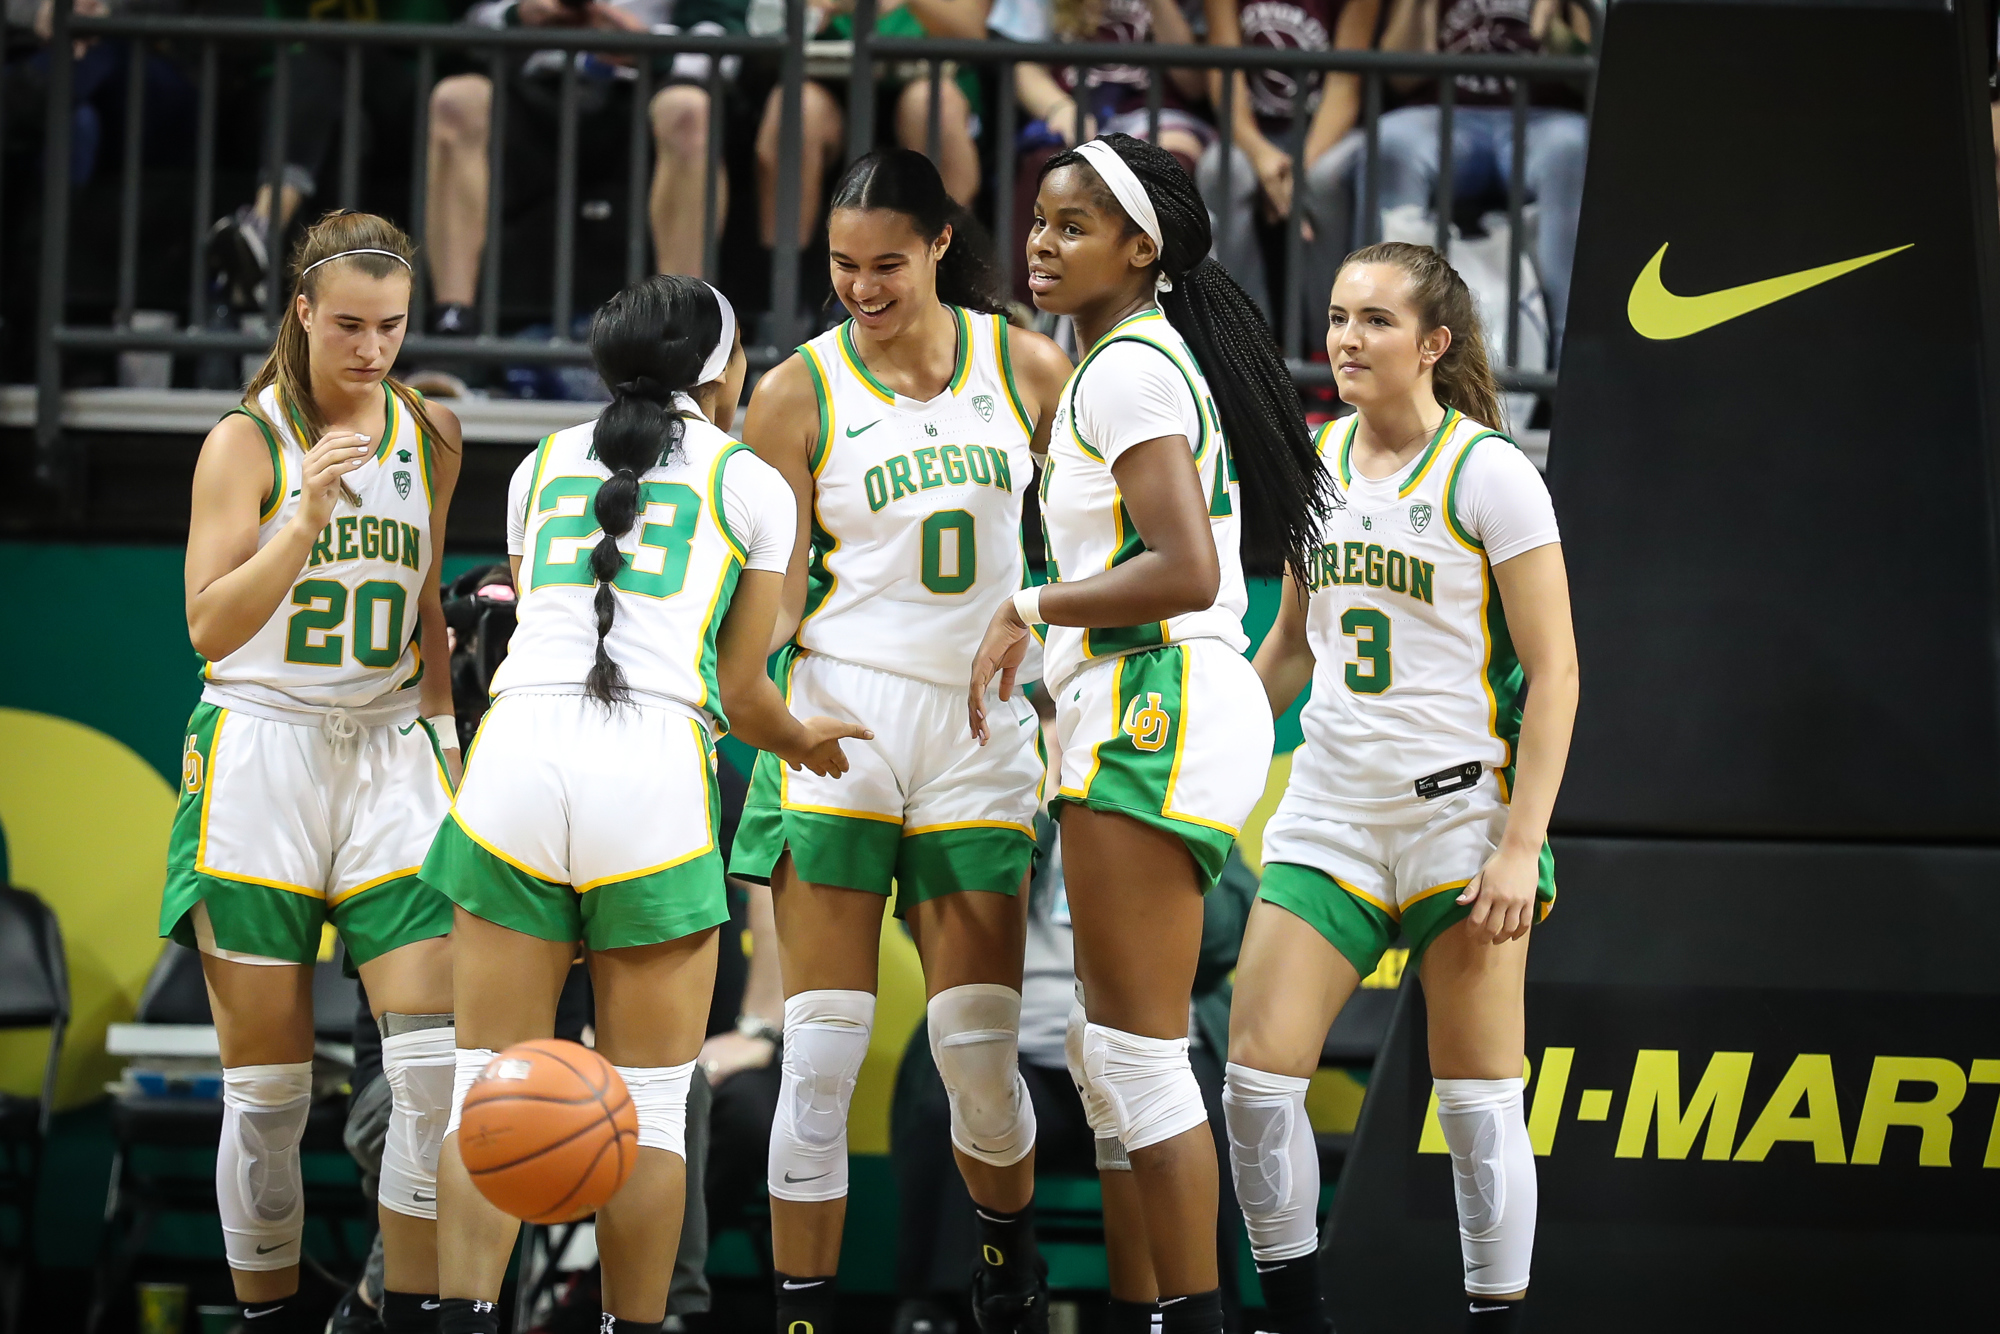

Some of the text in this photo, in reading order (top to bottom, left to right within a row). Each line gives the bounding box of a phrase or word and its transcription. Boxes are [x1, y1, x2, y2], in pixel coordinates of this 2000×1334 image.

[863, 444, 1013, 514] OREGON
[1410, 504, 1432, 521] PAC
[308, 515, 421, 573] REGON
[530, 475, 703, 601] 23
[920, 508, 977, 595] 0
[1415, 516, 1426, 527] 12
[284, 578, 408, 670] 20
[1340, 606, 1393, 696] 3
[1465, 765, 1478, 776] 42
